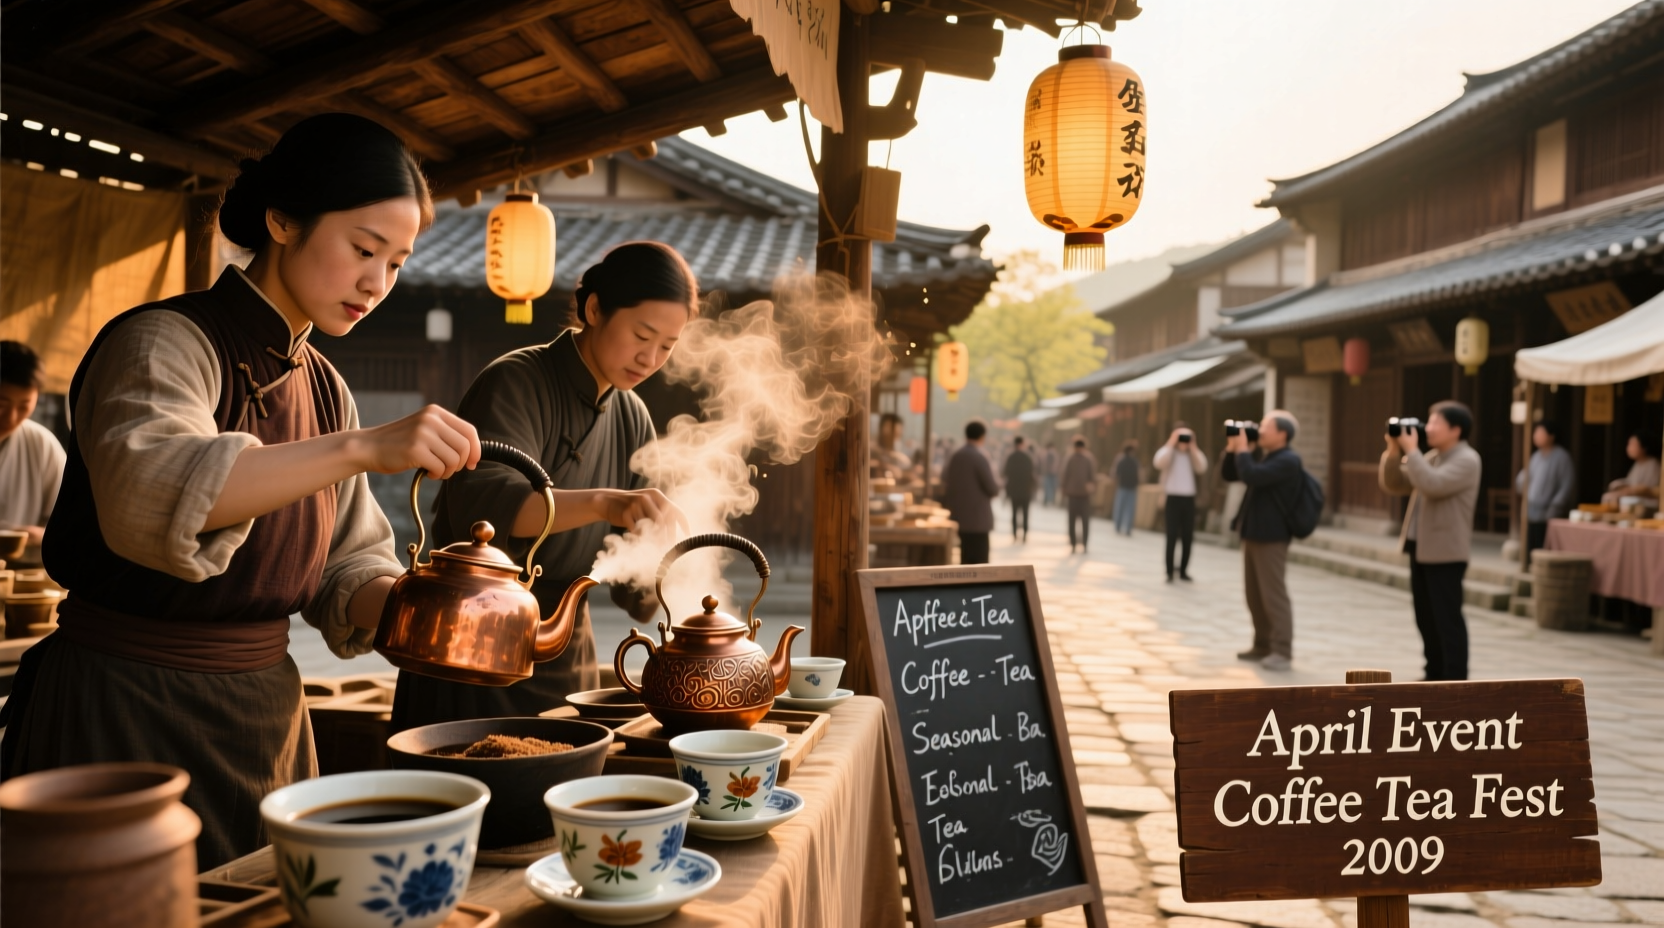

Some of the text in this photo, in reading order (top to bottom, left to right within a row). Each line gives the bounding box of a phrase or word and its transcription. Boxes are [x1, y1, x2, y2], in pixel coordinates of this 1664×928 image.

[971, 594, 1015, 628] Tea
[900, 657, 971, 701] Coffee
[995, 654, 1036, 686] Tea
[912, 713, 1002, 755] Seasonal
[1247, 706, 1524, 770] April Event
[1213, 773, 1565, 827] Coffee Tea Fest
[927, 813, 968, 844] Tea
[1340, 836, 1445, 876] 2009
